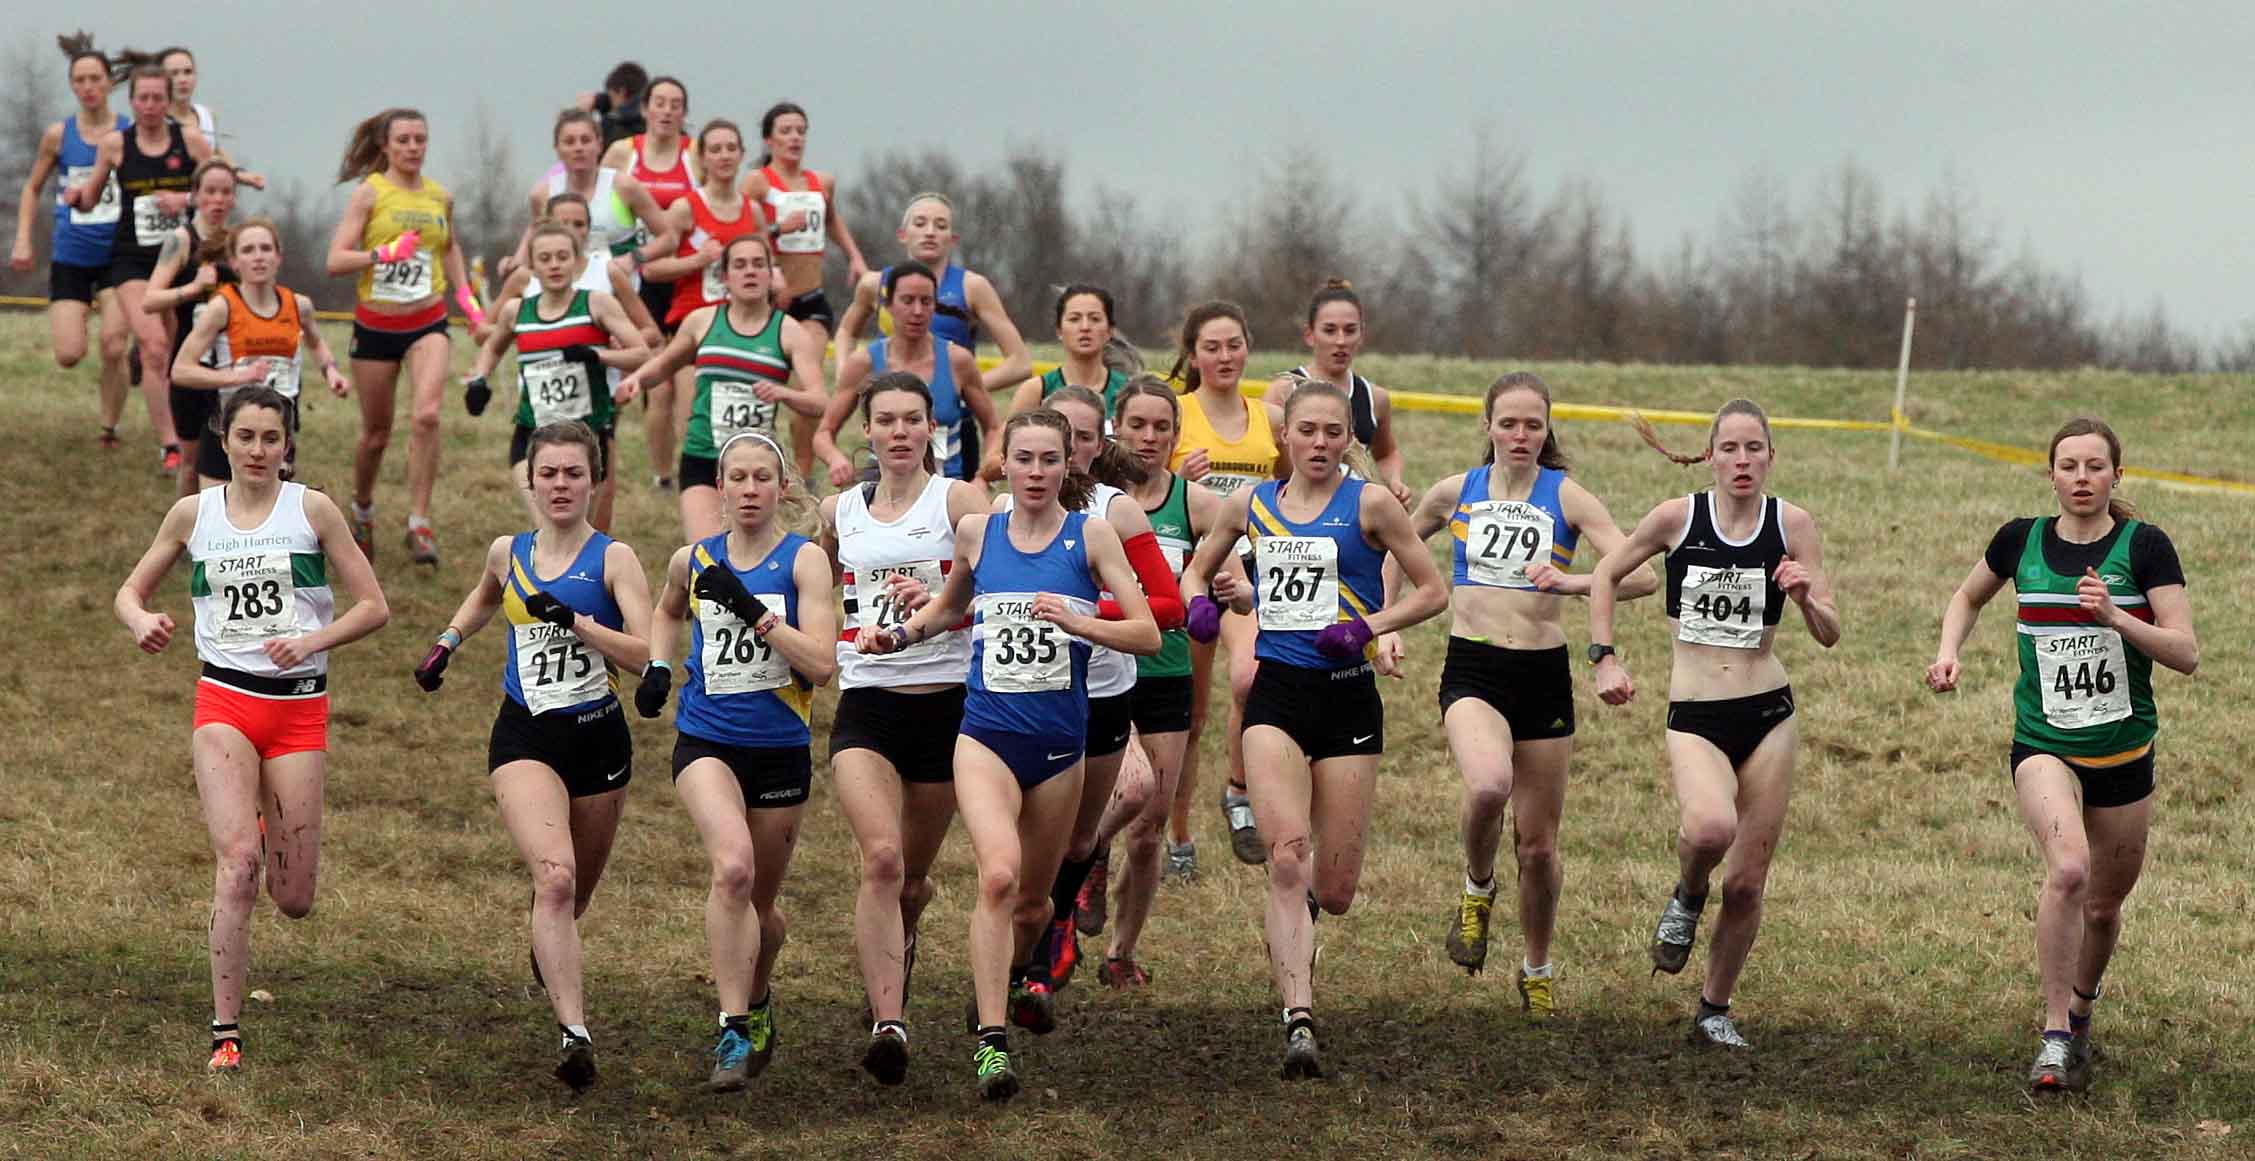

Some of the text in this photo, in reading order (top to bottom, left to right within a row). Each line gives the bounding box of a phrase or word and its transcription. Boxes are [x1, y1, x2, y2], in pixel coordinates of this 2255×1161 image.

[384, 262, 422, 286] 297
[541, 375, 579, 405] 432
[723, 404, 763, 428] 435
[1207, 476, 1246, 489] START
[1486, 503, 1531, 514] START
[208, 533, 293, 552] Leigh Harriers
[1268, 541, 1315, 553] START
[1480, 524, 1540, 562] 279
[219, 554, 266, 573] START
[241, 567, 277, 577] FITNESS
[1269, 566, 1324, 602] 267
[223, 580, 283, 621] 283
[995, 602, 1033, 616] STAR
[1694, 594, 1751, 624] 404
[715, 626, 772, 665] 269
[995, 627, 1057, 665] 335
[2049, 634, 2099, 653] START
[531, 642, 591, 686] 275
[1331, 667, 1359, 681] NIKE
[2054, 659, 2115, 699] 446
[577, 708, 605, 724] NIKE
